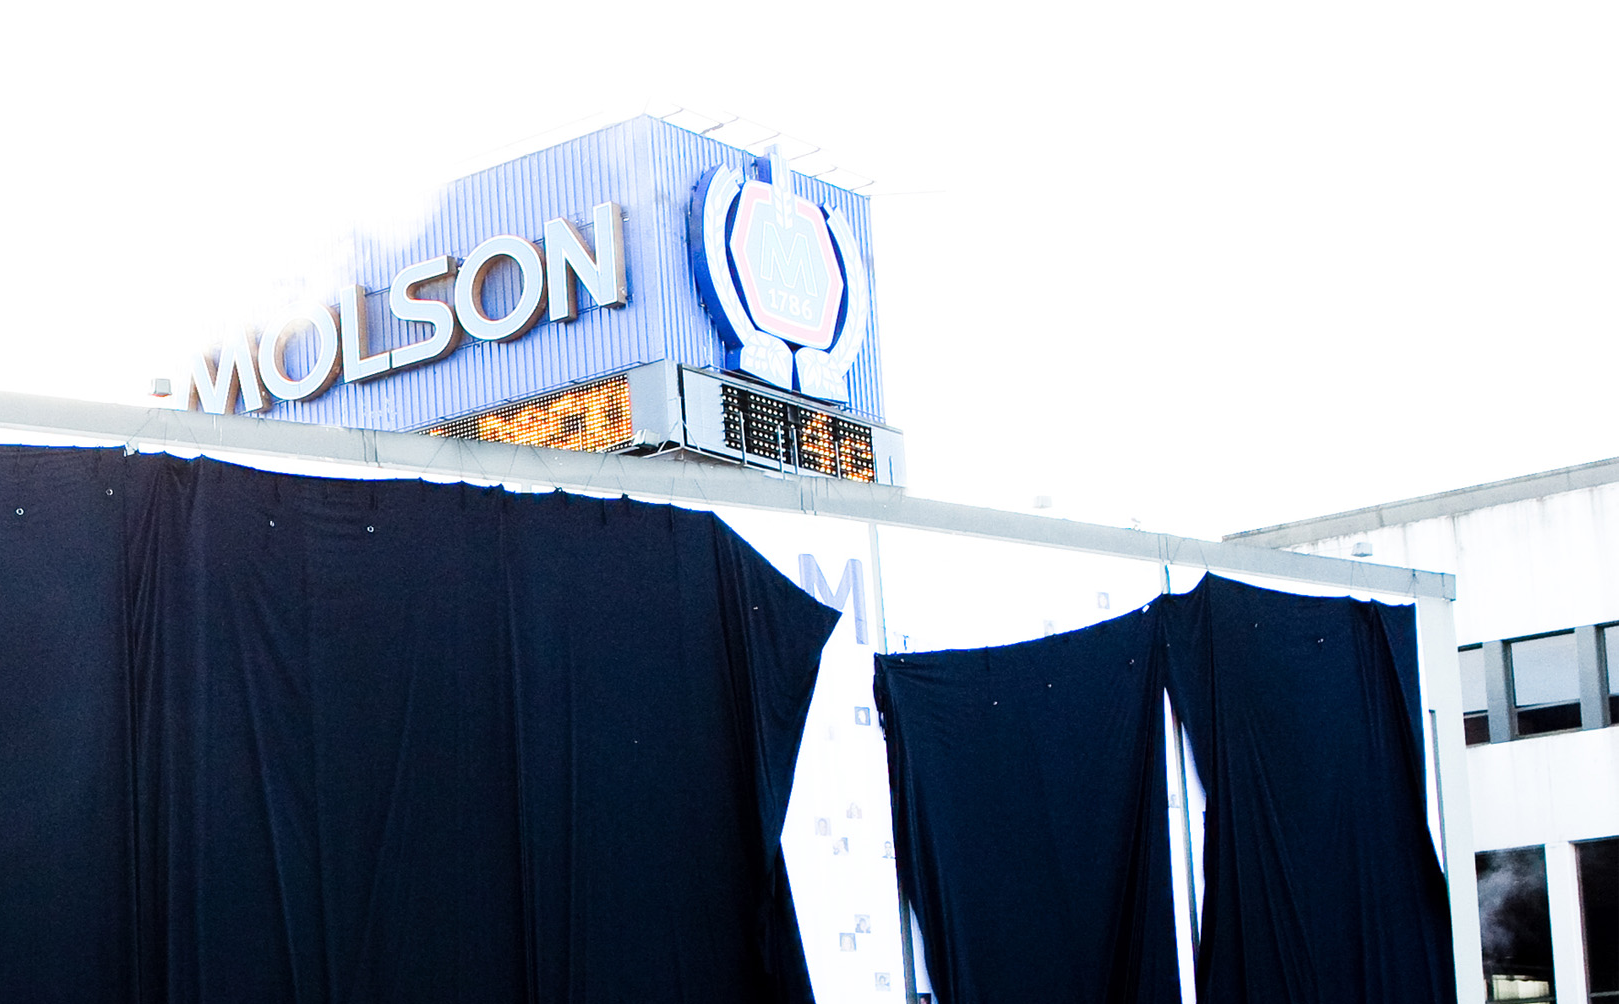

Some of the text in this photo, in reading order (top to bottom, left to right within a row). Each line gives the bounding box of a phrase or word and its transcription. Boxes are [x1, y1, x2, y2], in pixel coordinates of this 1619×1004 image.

[760, 221, 819, 298] M
[179, 201, 627, 411] MOLSON
[768, 288, 813, 321] 1786
[798, 553, 869, 646] M
